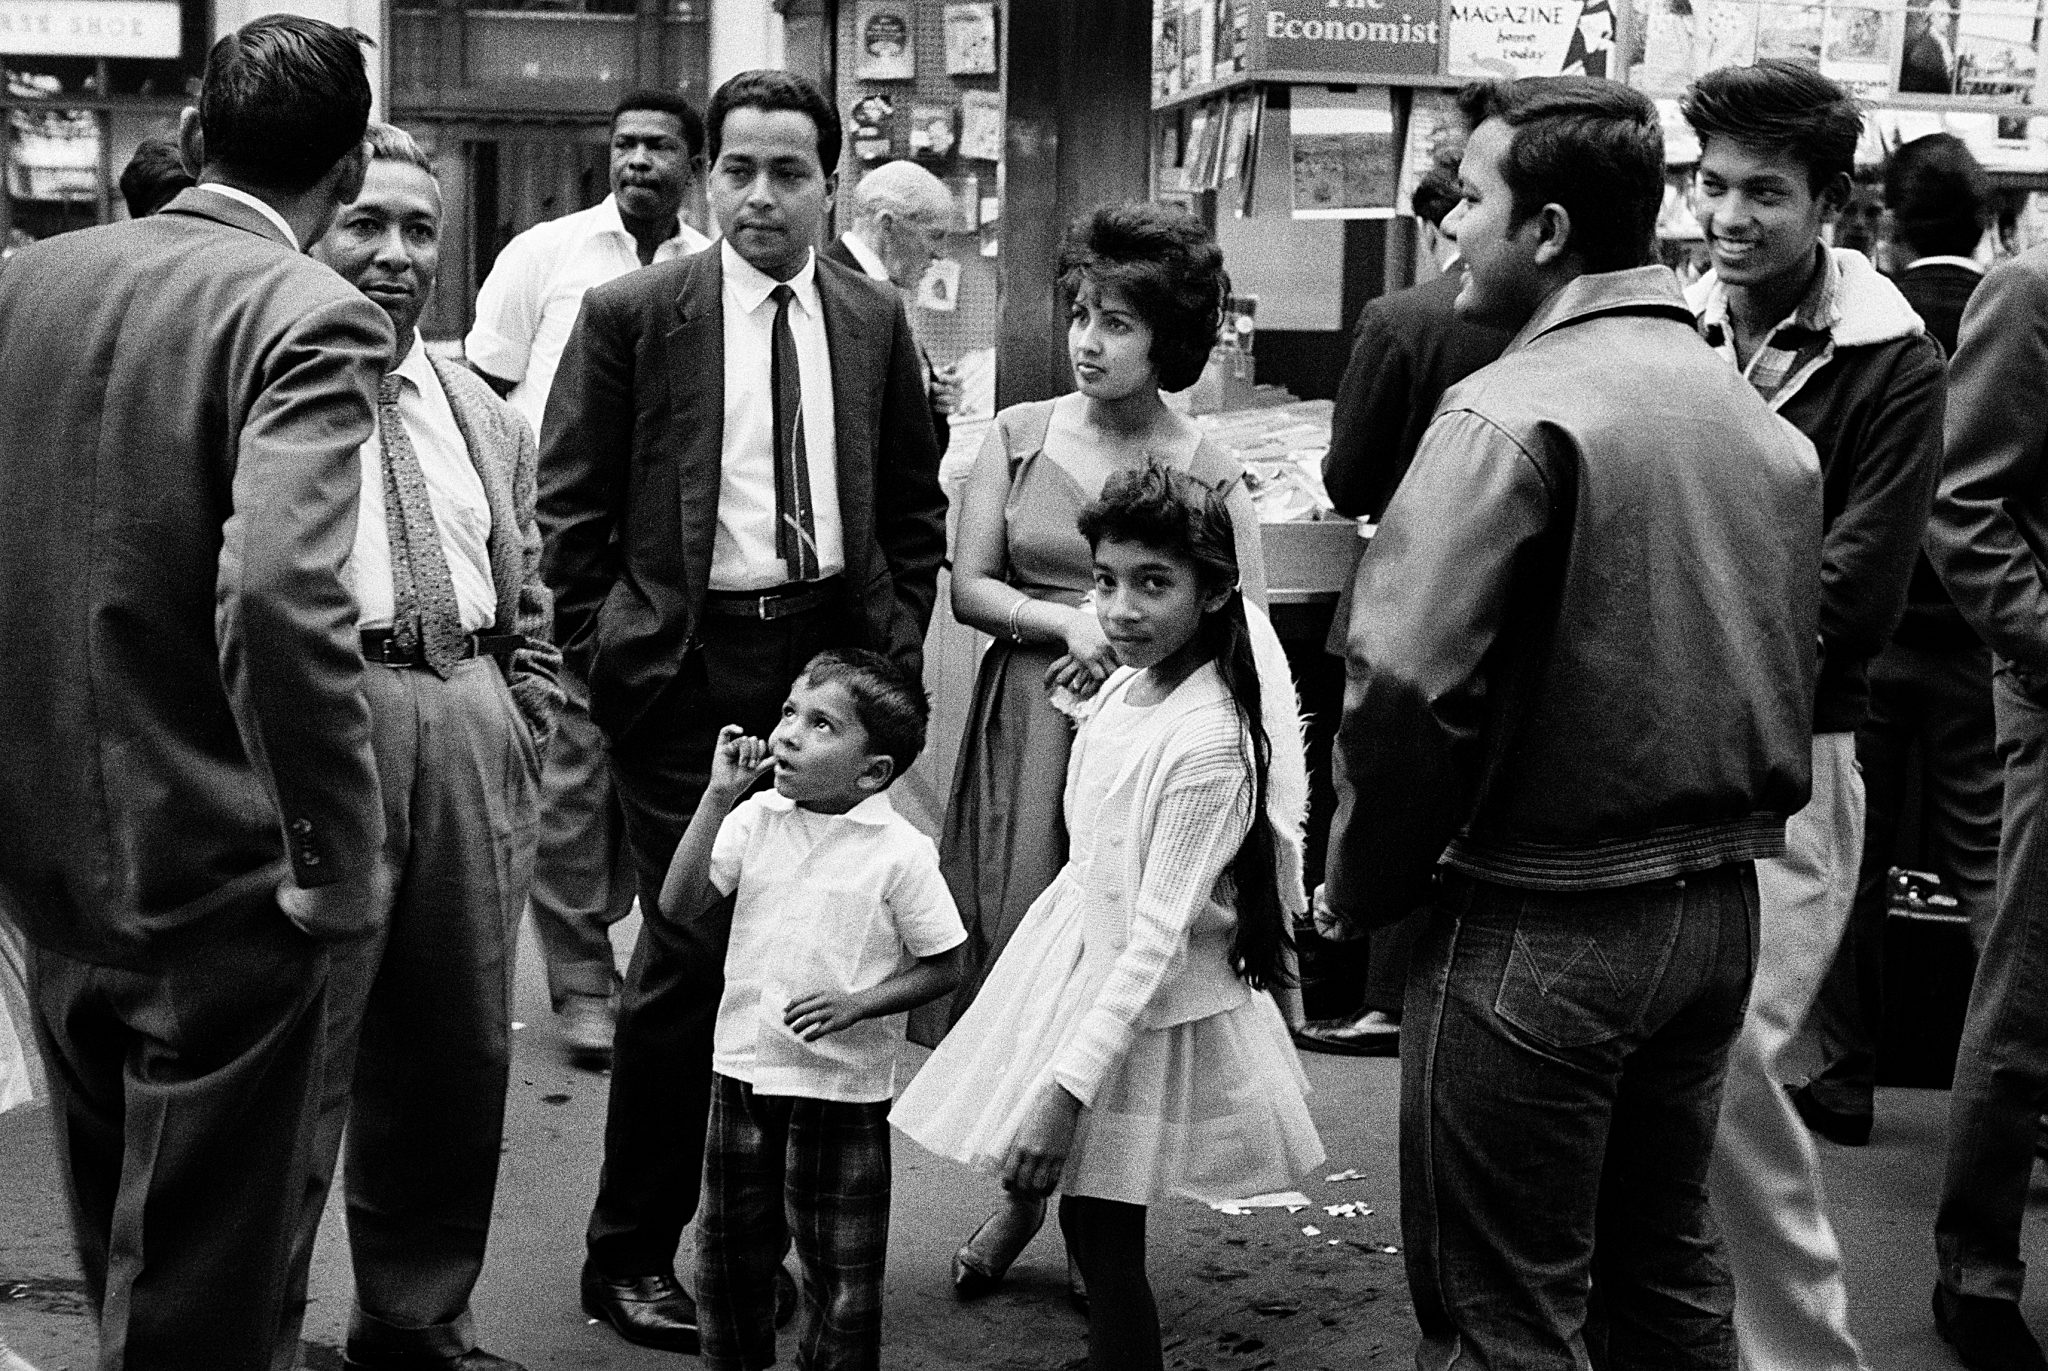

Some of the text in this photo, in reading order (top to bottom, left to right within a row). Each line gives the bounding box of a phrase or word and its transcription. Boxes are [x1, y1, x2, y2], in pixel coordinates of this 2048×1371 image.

[1450, 5, 1563, 25] MAGAZINE
[69, 16, 145, 37] SHOE
[1265, 10, 1441, 45] Economist
